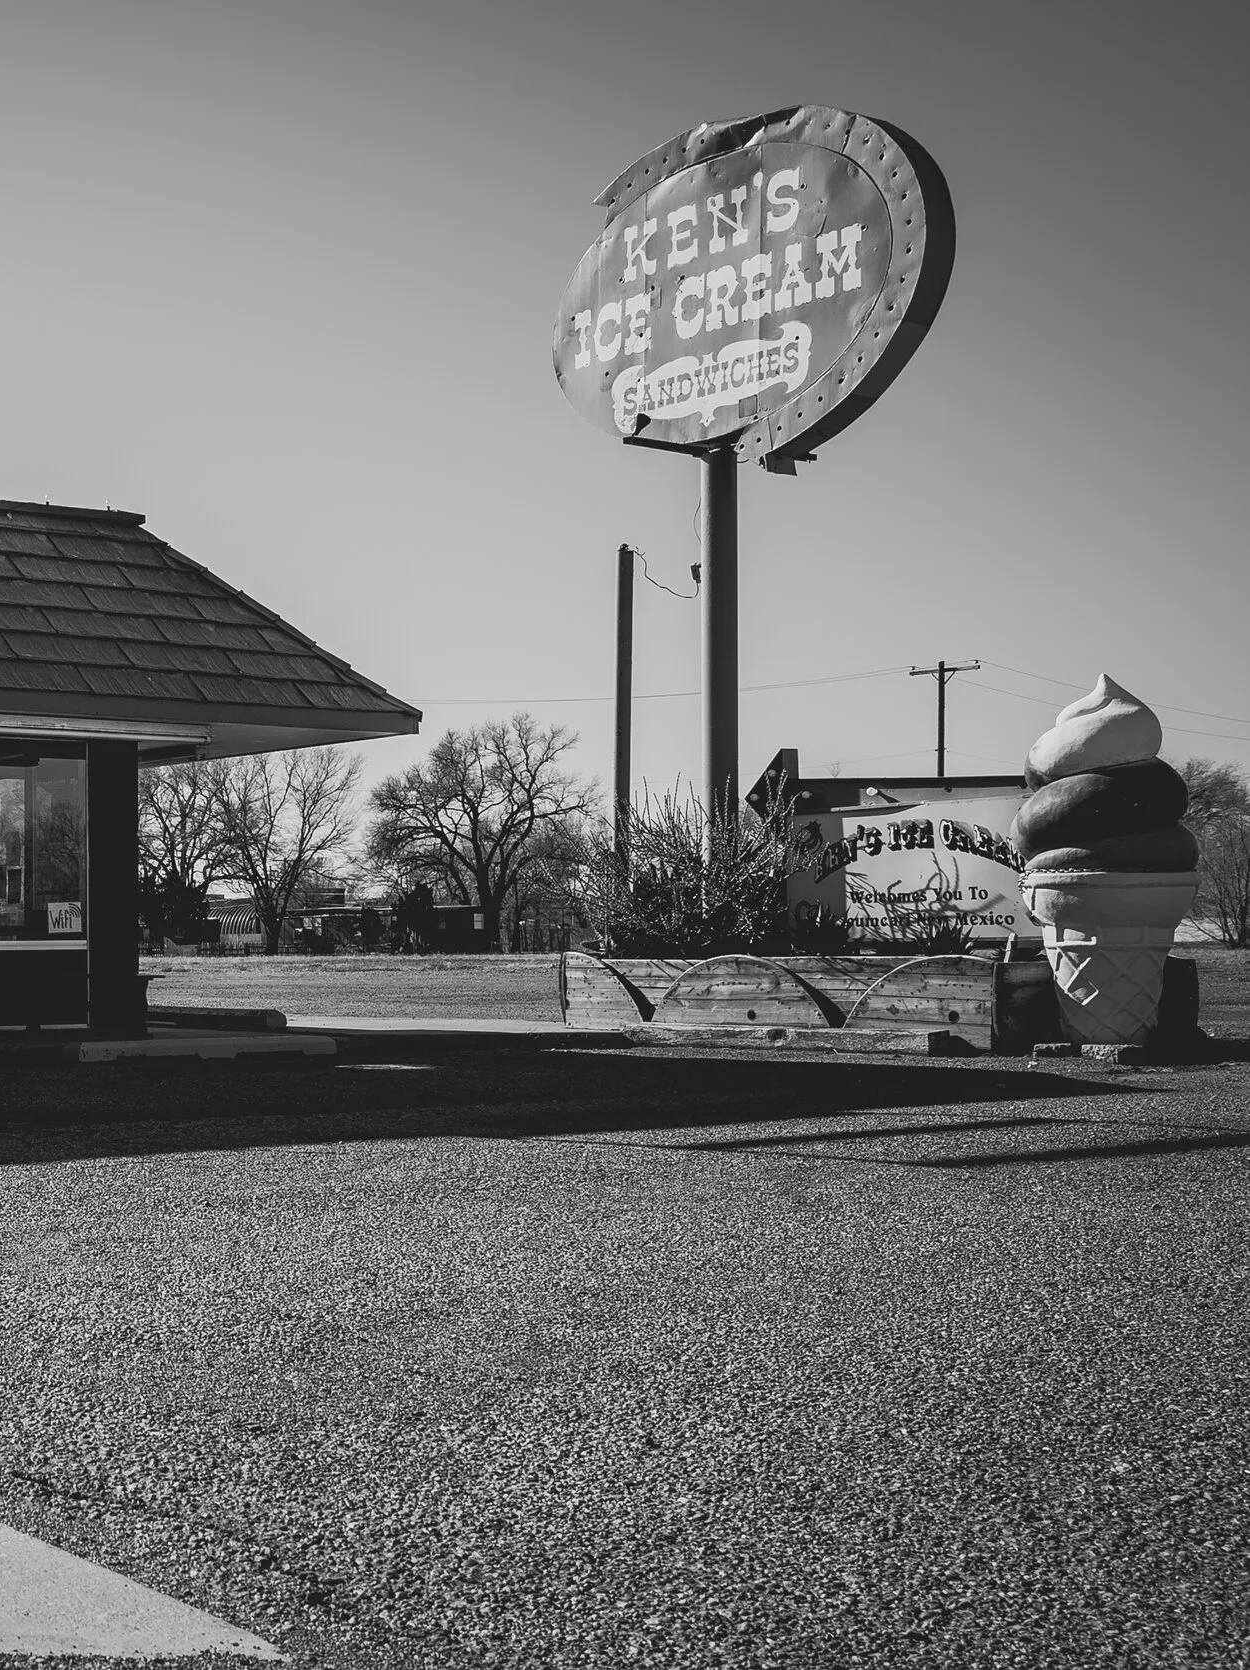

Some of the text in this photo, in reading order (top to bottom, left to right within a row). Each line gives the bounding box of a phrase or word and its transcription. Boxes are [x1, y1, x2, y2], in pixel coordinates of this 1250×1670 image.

[622, 167, 800, 284] KEN'S
[573, 223, 863, 369] ICE CREAM
[622, 342, 800, 416] SANDWICHES
[886, 818, 934, 851] ICE
[848, 886, 989, 904] Welcomes You To
[49, 908, 73, 929] WiFi
[844, 914, 910, 928] cumcari
[955, 911, 1015, 926] Mexico
